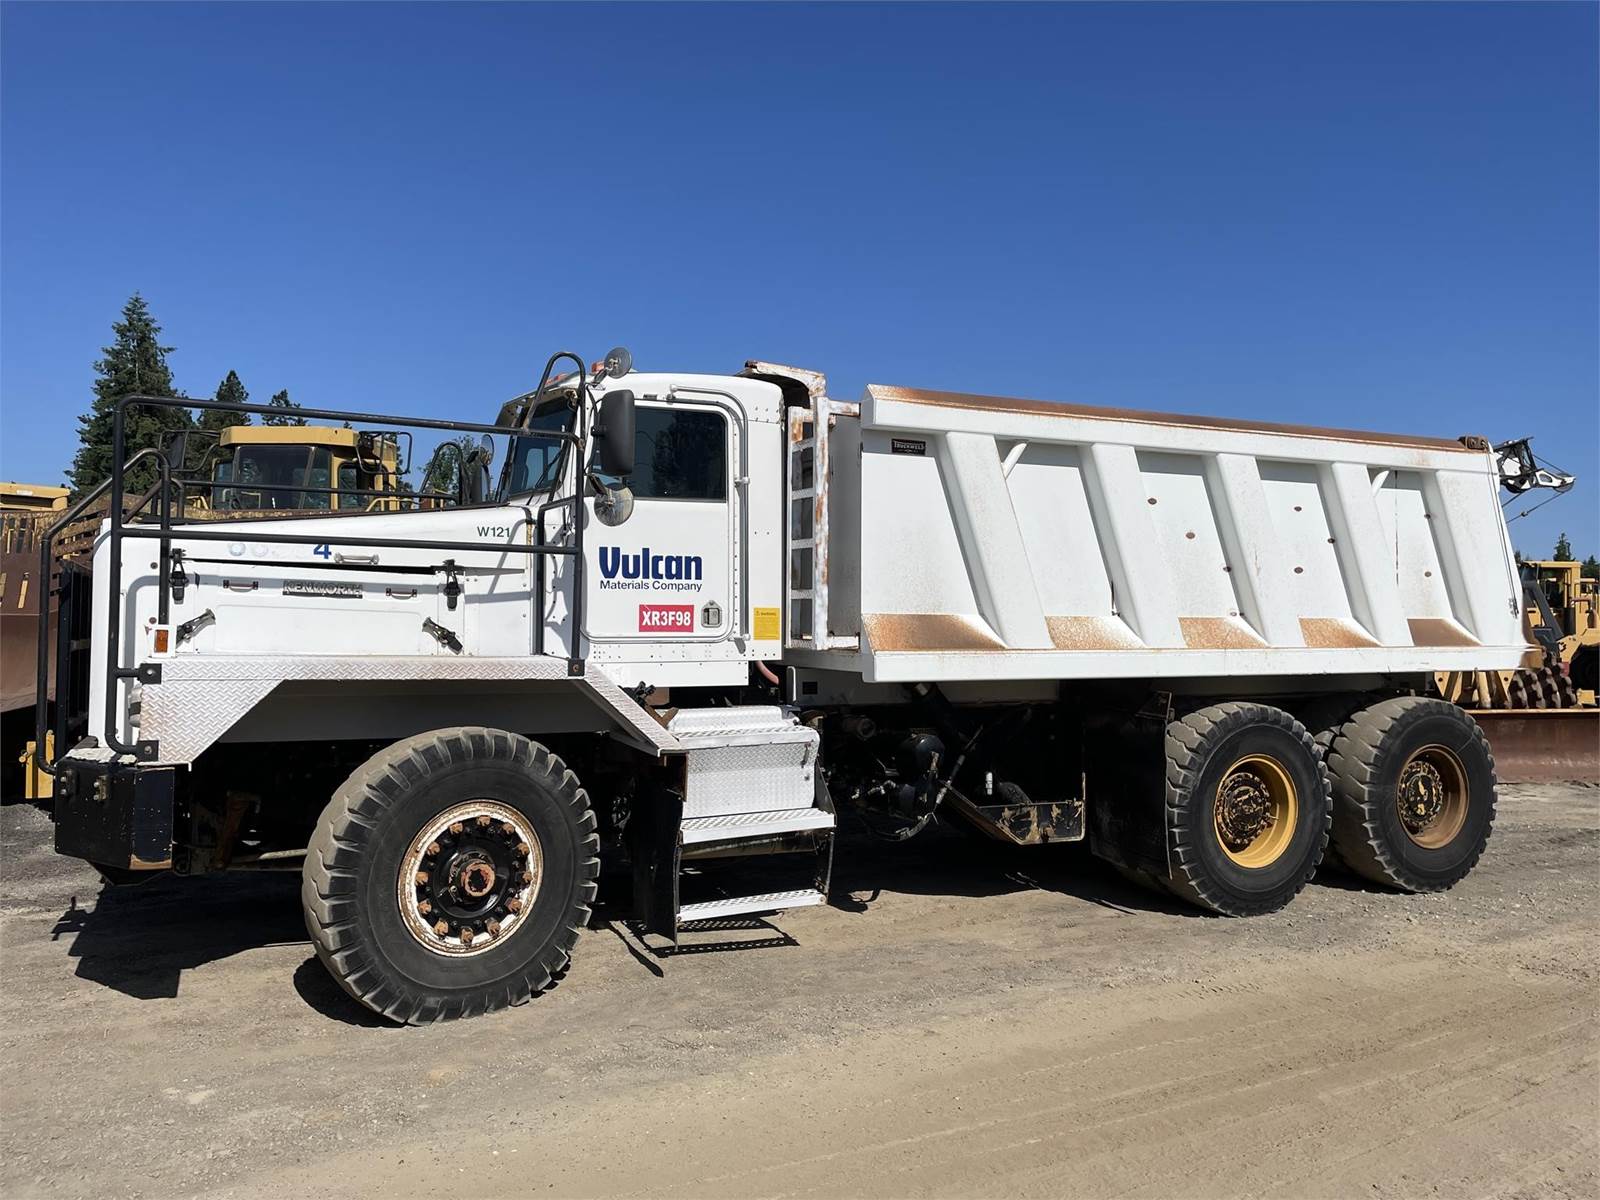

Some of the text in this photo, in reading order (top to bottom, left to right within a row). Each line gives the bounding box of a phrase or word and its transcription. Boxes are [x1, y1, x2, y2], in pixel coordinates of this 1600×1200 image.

[477, 526, 510, 537] W121
[313, 543, 332, 559] 4
[599, 546, 702, 580] Vulcan
[600, 580, 703, 592] Materials Company
[642, 610, 692, 626] XR3F98
